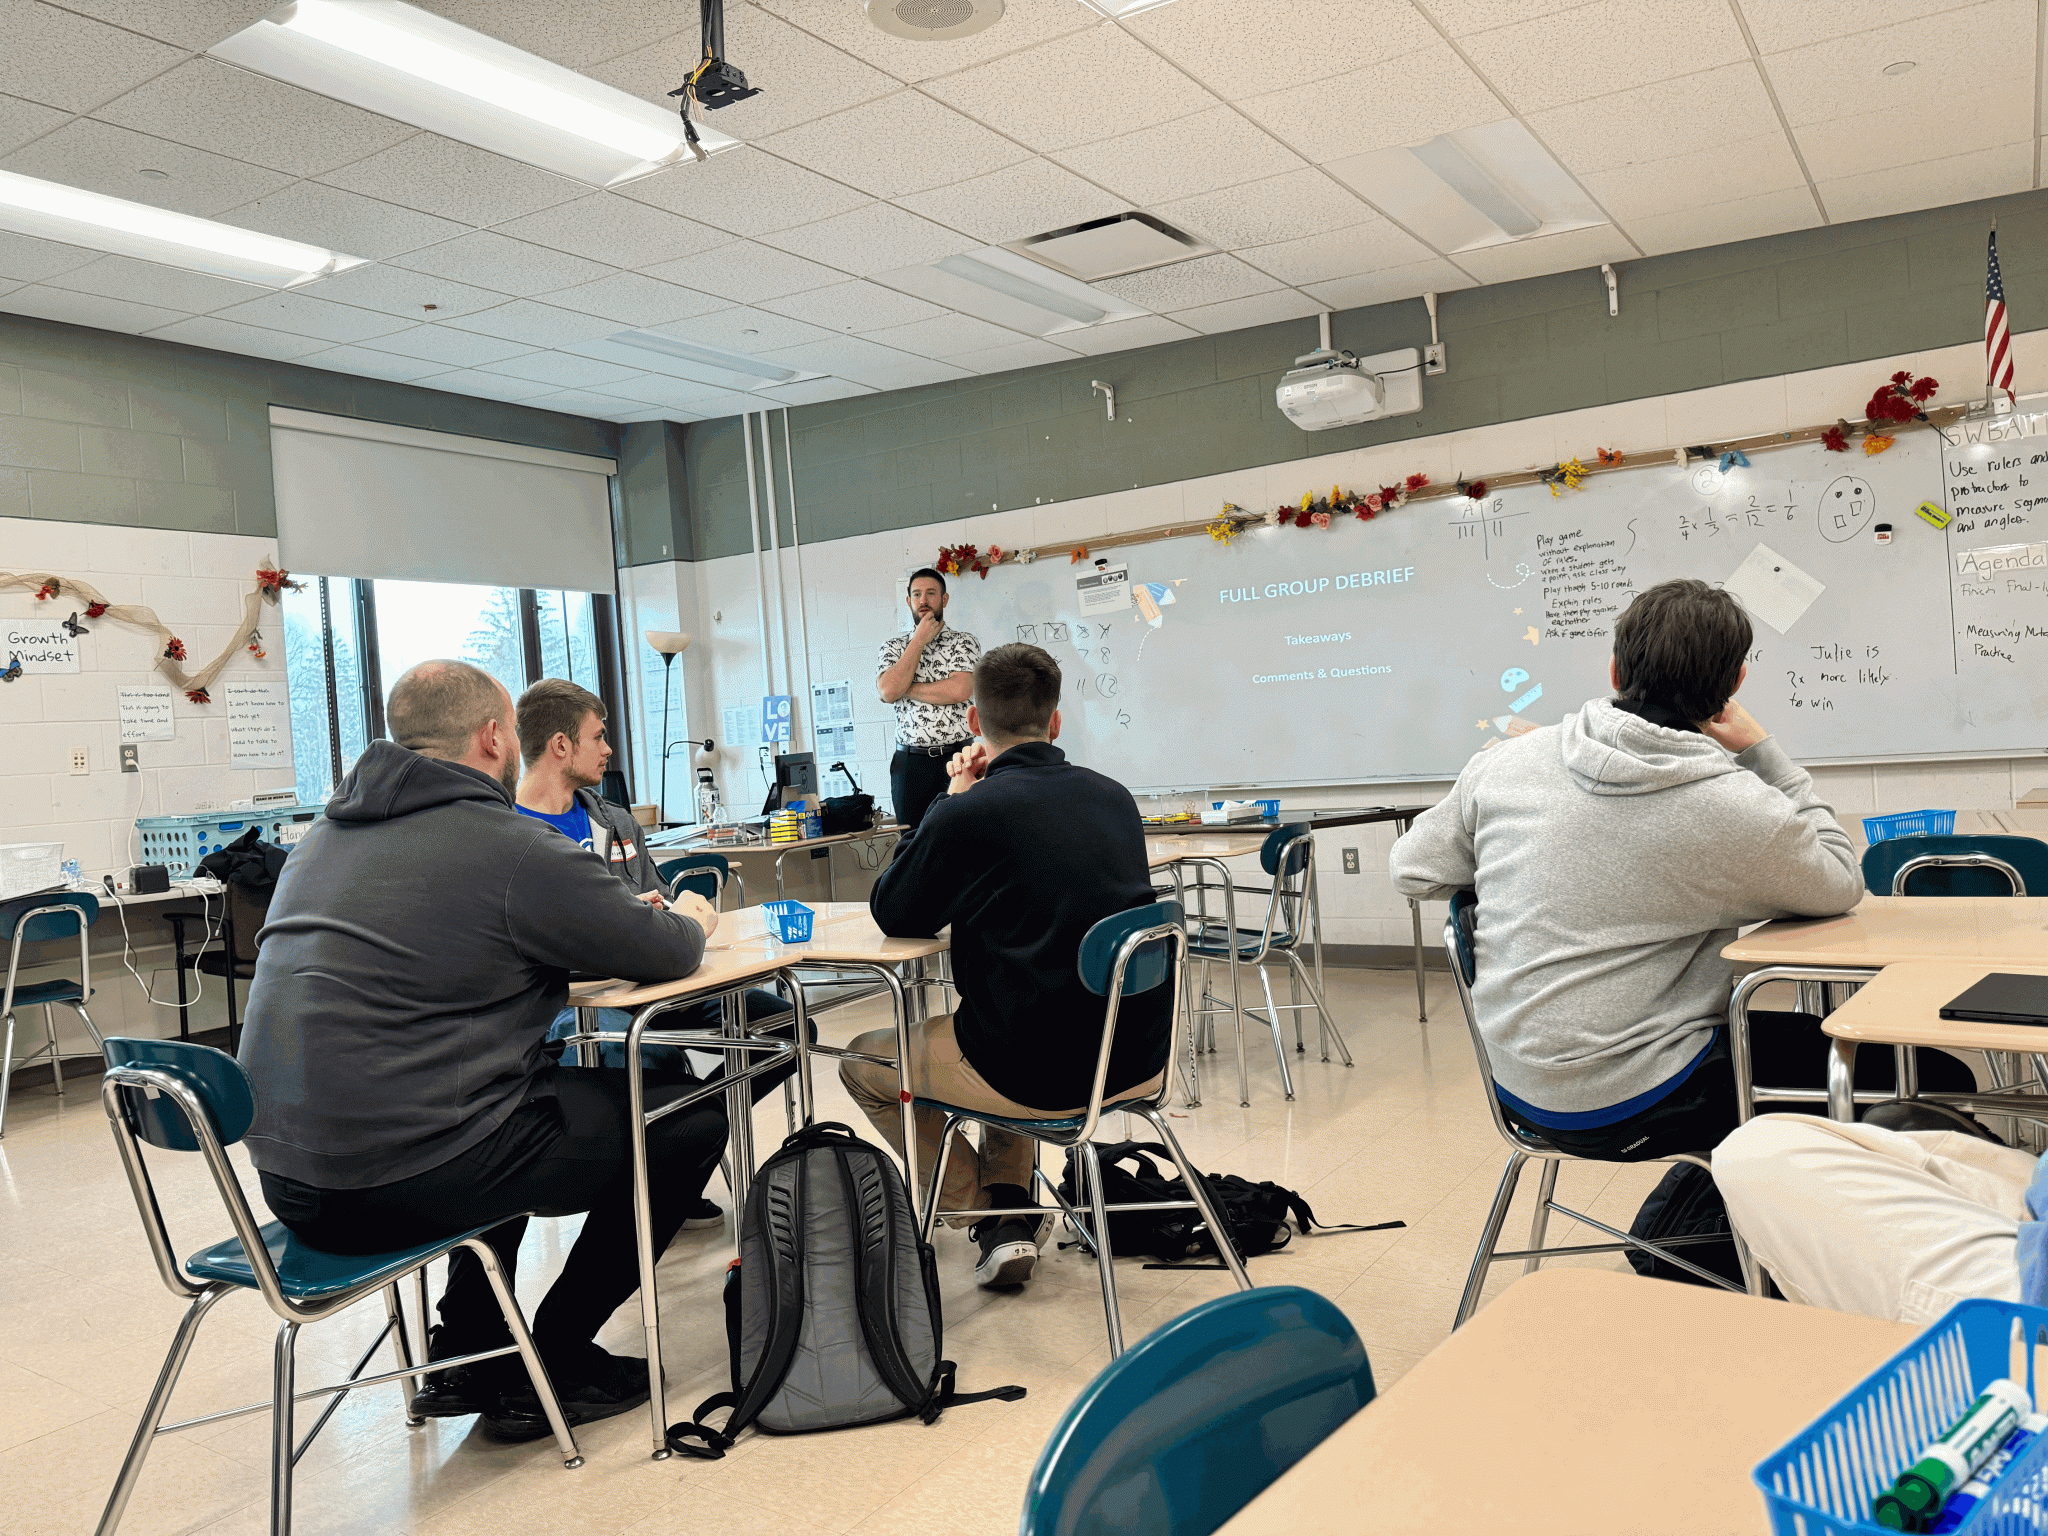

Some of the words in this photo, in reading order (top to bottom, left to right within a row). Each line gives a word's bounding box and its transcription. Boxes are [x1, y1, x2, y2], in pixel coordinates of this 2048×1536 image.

[1949, 461, 1978, 477] Use
[1987, 456, 2022, 472] rulers
[2019, 474, 2029, 487] to
[1493, 498, 1503, 513] B
[1955, 504, 2005, 517] measure
[1956, 520, 1975, 533] and
[1558, 529, 1584, 545] game
[1538, 548, 1570, 558] without
[1961, 546, 2045, 581] Agenda
[1219, 586, 1261, 604] FULL
[1264, 577, 1330, 598] GROUP
[1335, 566, 1415, 590] DEBRIEF
[1611, 578, 1634, 589] rounds
[1582, 596, 1602, 606] rules
[8, 631, 68, 645] Growth
[1284, 631, 1352, 646] Takeaways
[9, 649, 74, 662] Mindset
[1810, 642, 1853, 663] Julie
[1866, 645, 1880, 659] is
[1252, 669, 1315, 684] Comments
[1317, 668, 1328, 679] &
[1330, 664, 1392, 679] Questions
[1820, 672, 1848, 683] more
[1789, 692, 1803, 708] to
[1810, 696, 1834, 711] win
